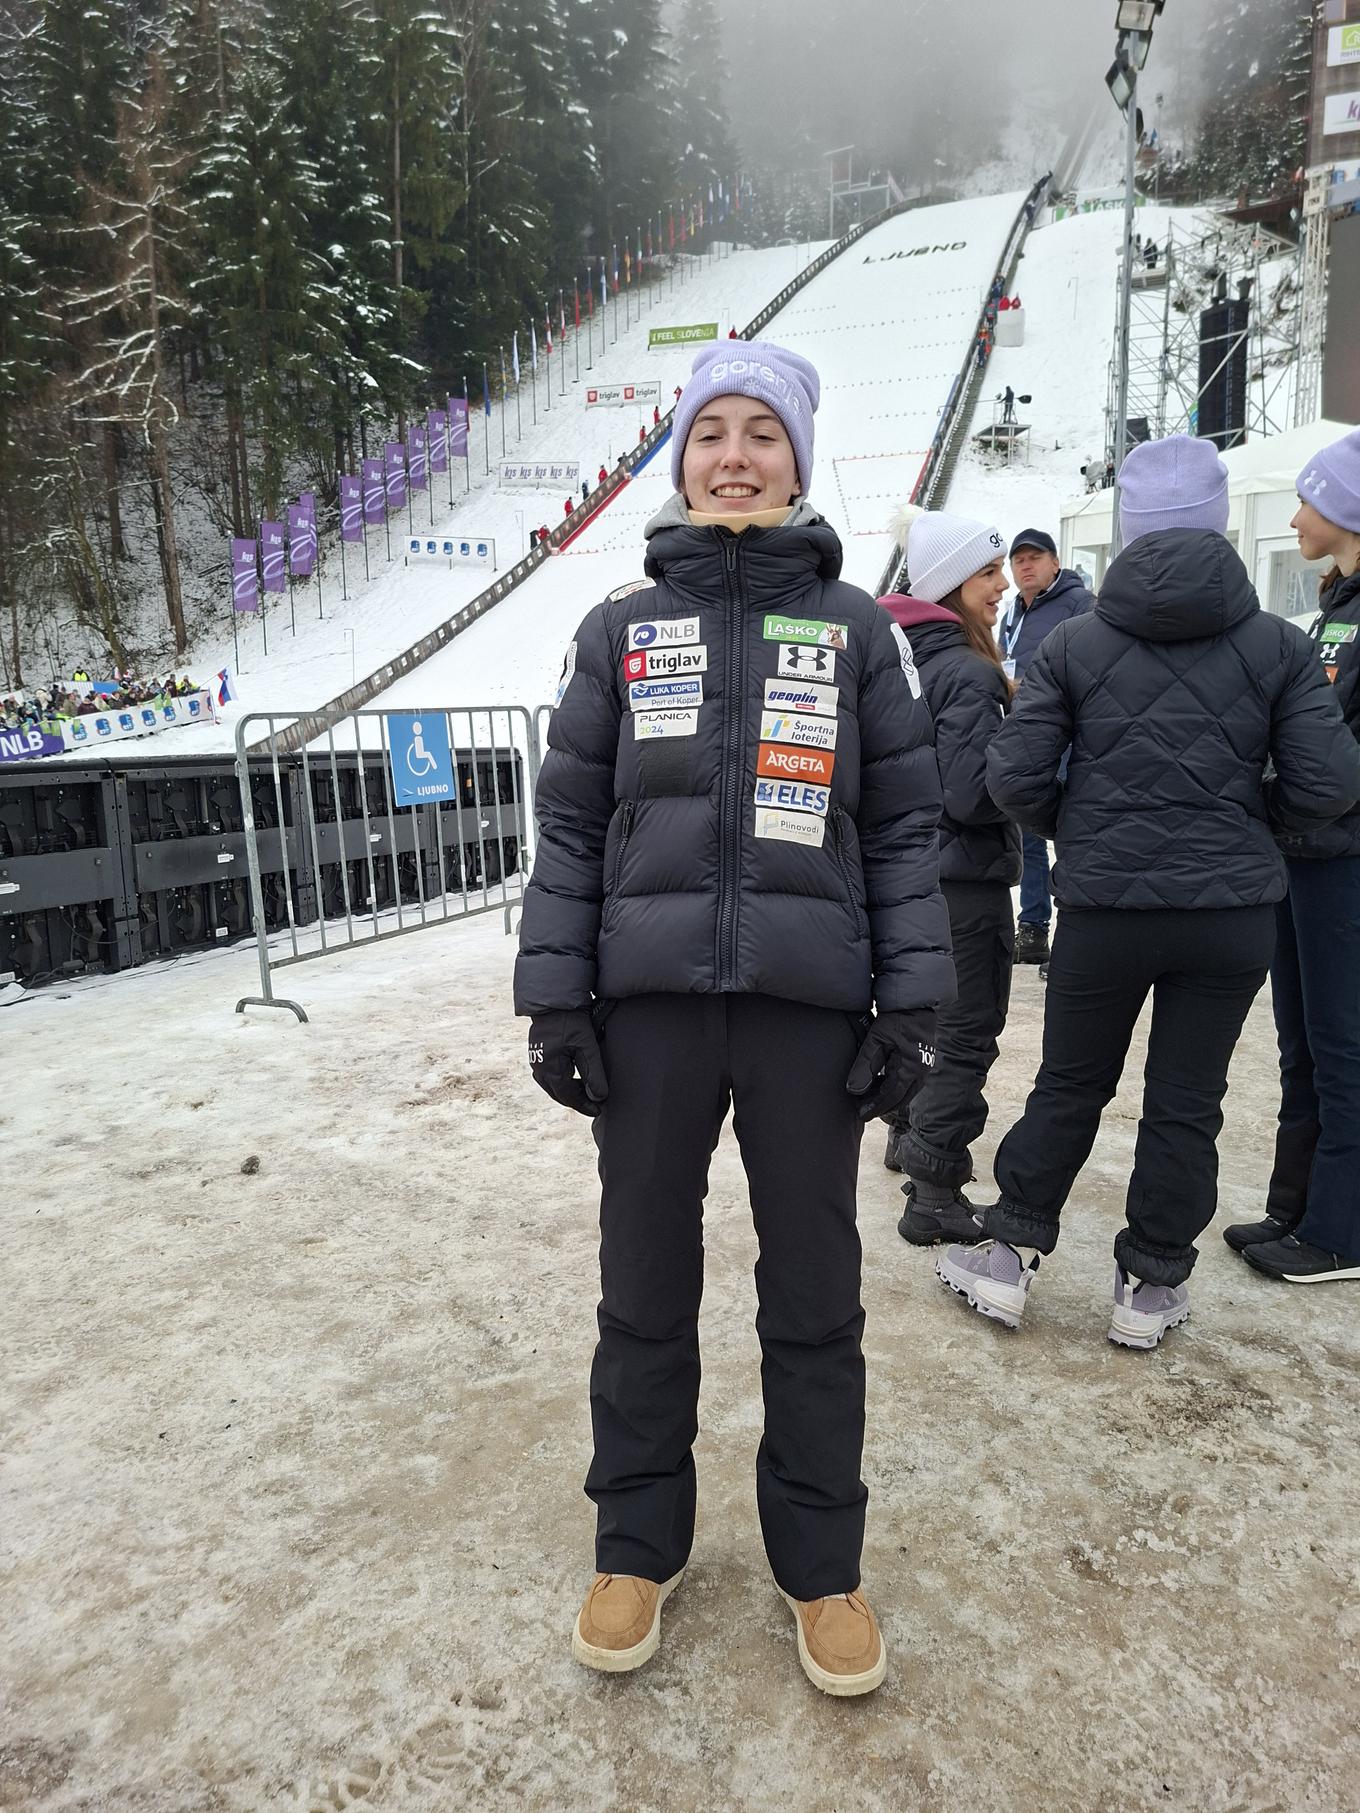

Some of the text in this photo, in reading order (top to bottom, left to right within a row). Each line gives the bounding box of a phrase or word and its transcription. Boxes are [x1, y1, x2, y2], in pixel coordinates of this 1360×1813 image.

[657, 332, 676, 340] FEEL
[599, 388, 658, 401] triglav triglav
[660, 624, 695, 640] NLB
[648, 652, 702, 672] triglav
[803, 674, 833, 682] ARMOUR
[649, 683, 698, 696] LUKA KOPER
[767, 688, 818, 704] geoplin
[651, 698, 666, 707] Port
[676, 696, 698, 706] Koper
[640, 712, 692, 722] PLANICA
[640, 725, 664, 735] 2024
[793, 721, 835, 736] Športna
[0, 731, 44, 757] NLB
[791, 732, 828, 745] loterija
[766, 750, 825, 773] ARGETA
[417, 784, 449, 796] LJUBNO
[778, 784, 828, 811] ELES
